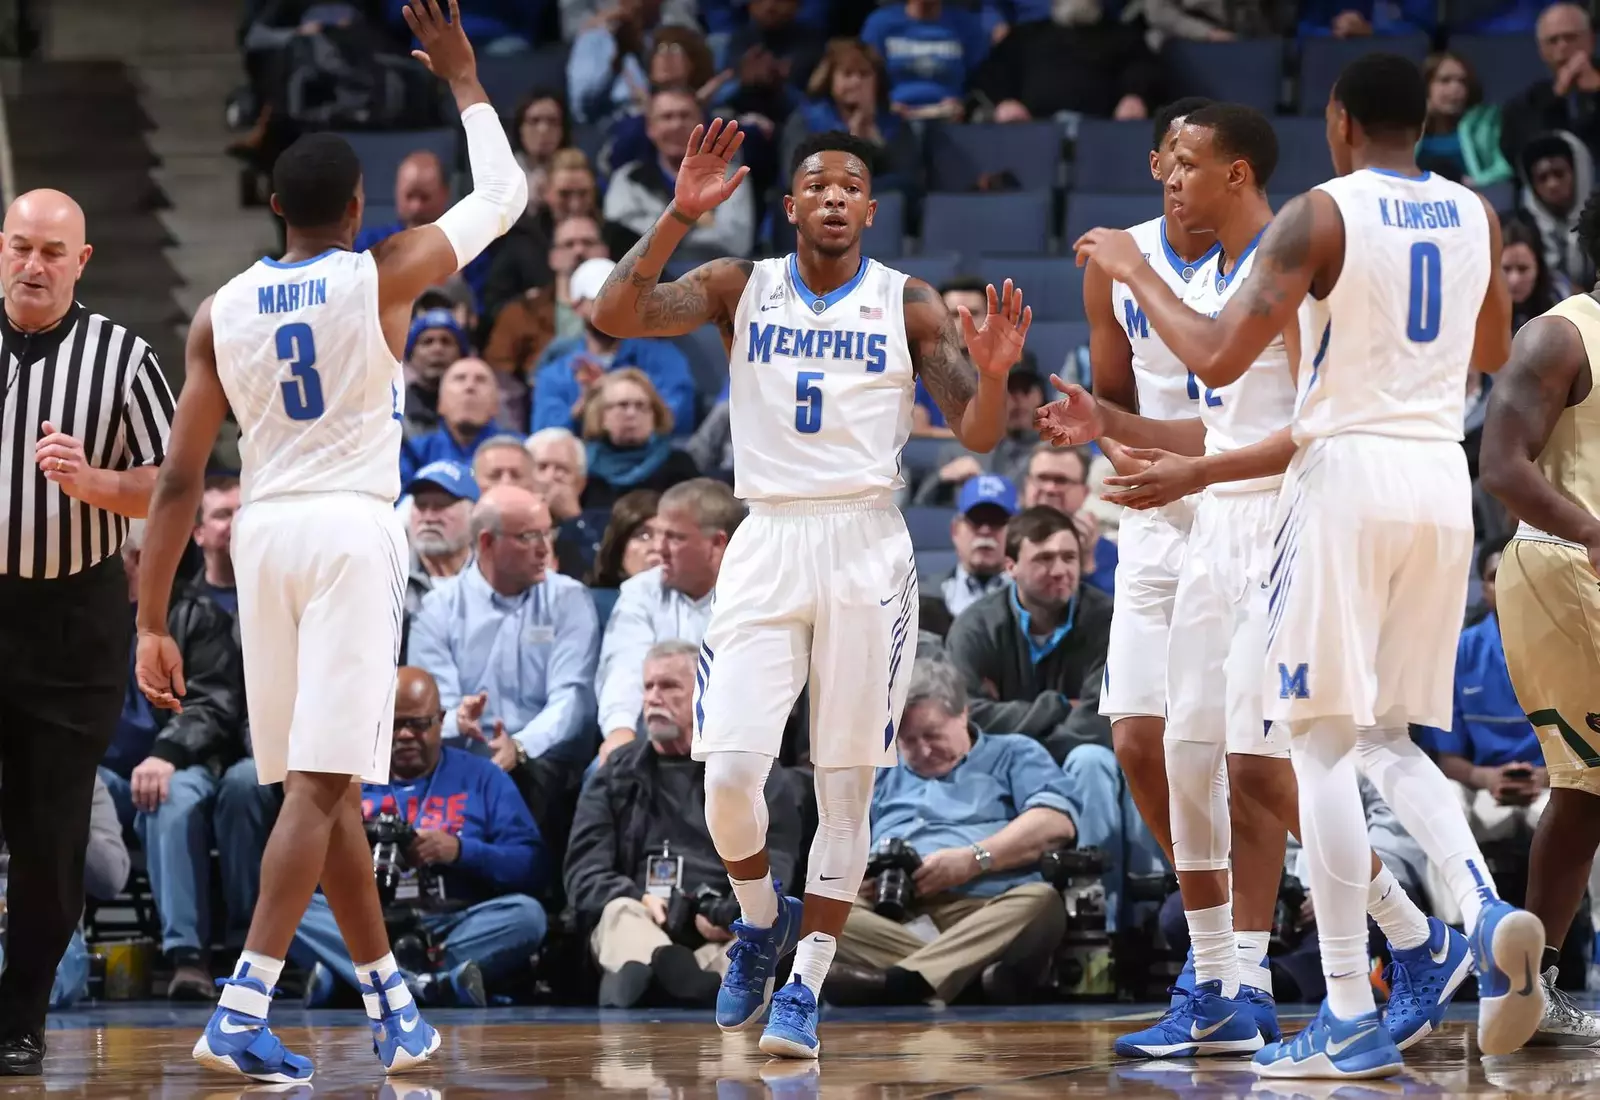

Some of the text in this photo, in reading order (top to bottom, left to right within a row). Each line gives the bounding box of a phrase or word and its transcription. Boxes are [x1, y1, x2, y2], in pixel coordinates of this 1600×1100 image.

[1378, 197, 1461, 229] K.LAWSON
[257, 277, 327, 314] MARTIN
[1406, 241, 1442, 342] 0
[275, 322, 325, 421] 3
[747, 321, 887, 374] MEMPHIS
[795, 371, 824, 434] 5
[1278, 662, 1310, 699] M
